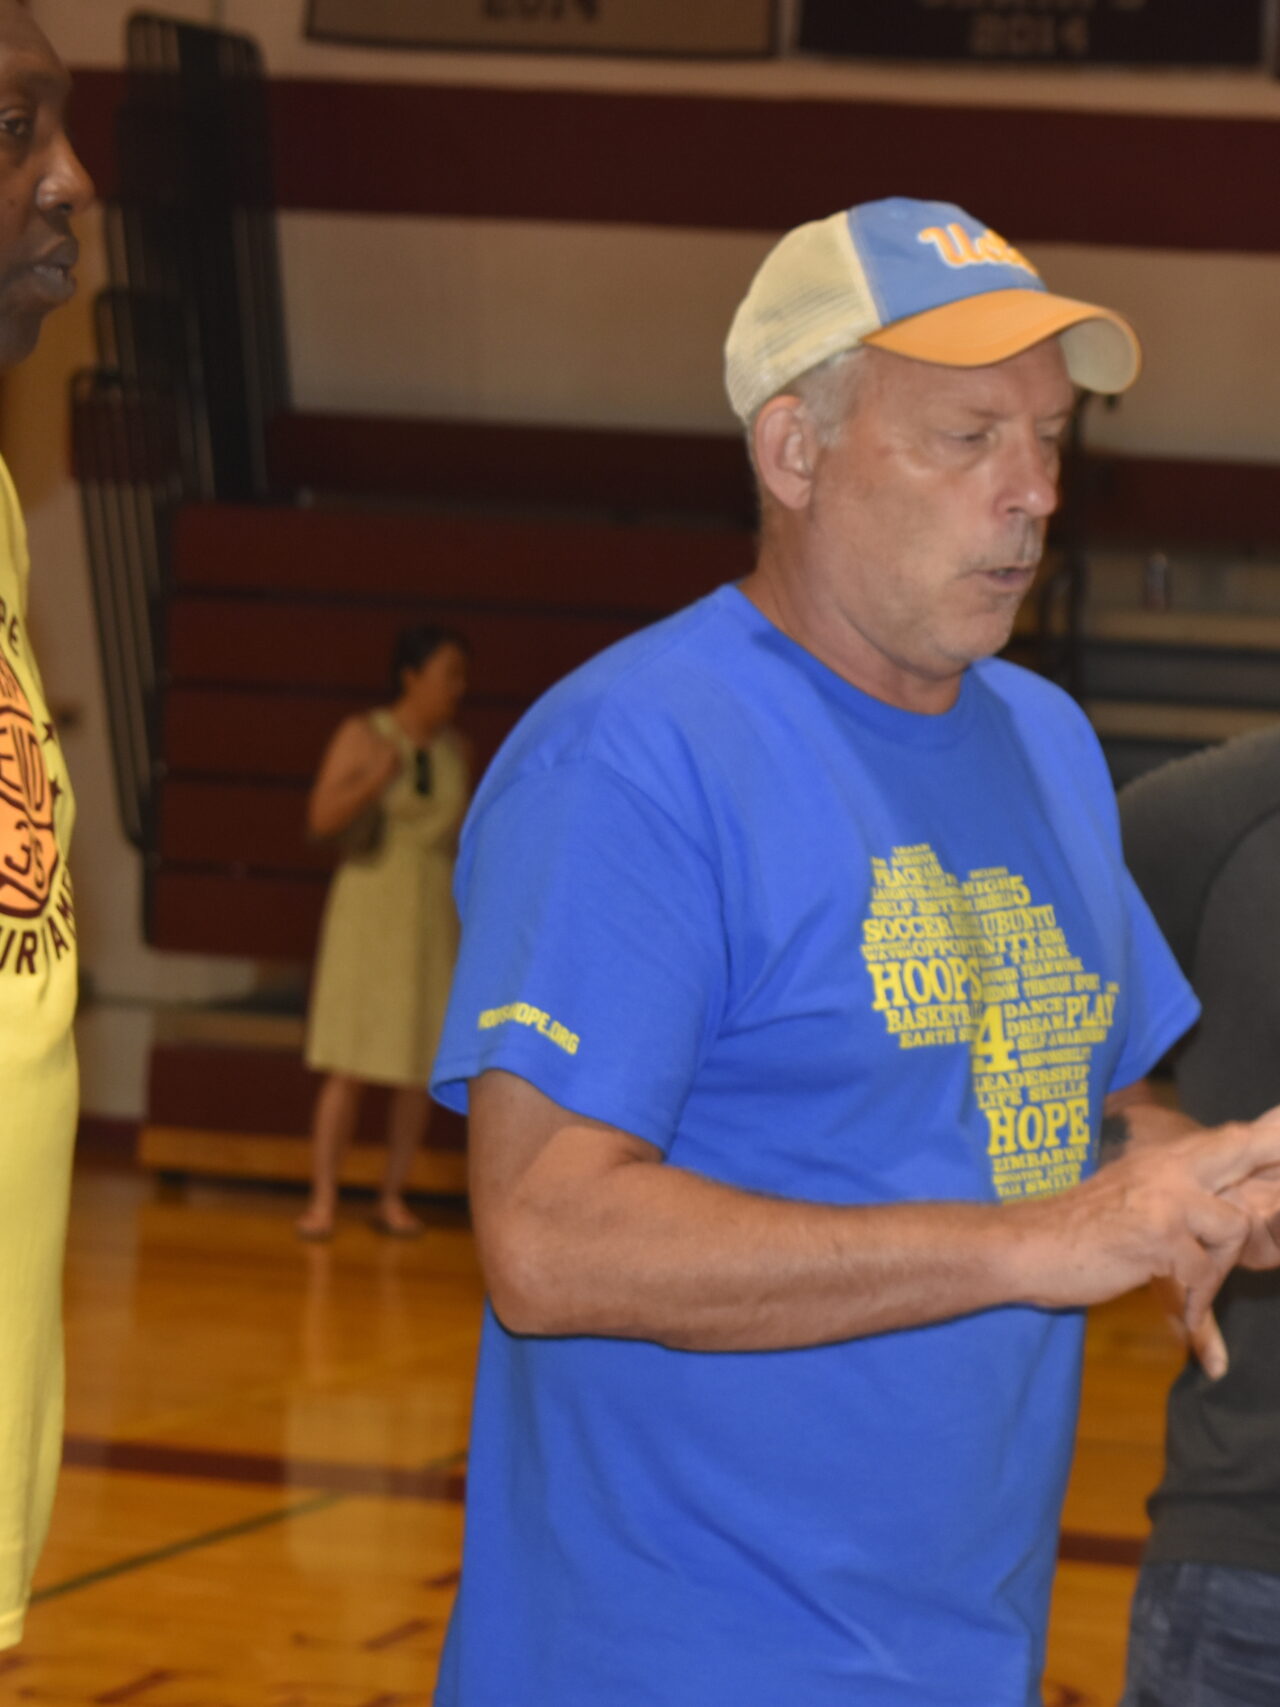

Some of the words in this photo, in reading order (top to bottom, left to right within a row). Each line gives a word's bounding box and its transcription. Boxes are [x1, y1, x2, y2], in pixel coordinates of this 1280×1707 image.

[1011, 876, 1030, 905] 5
[864, 915, 951, 942] SOCCER
[982, 904, 1055, 936] UBUNTU
[868, 957, 981, 1010] HOOPS
[1005, 997, 1063, 1019] DANCE
[1067, 995, 1115, 1028] PLAY
[974, 1003, 1018, 1073] 4
[1006, 1015, 1063, 1037] DREAM
[975, 1065, 1089, 1093] LEADERSHIP
[986, 1097, 1090, 1156] HOPE
